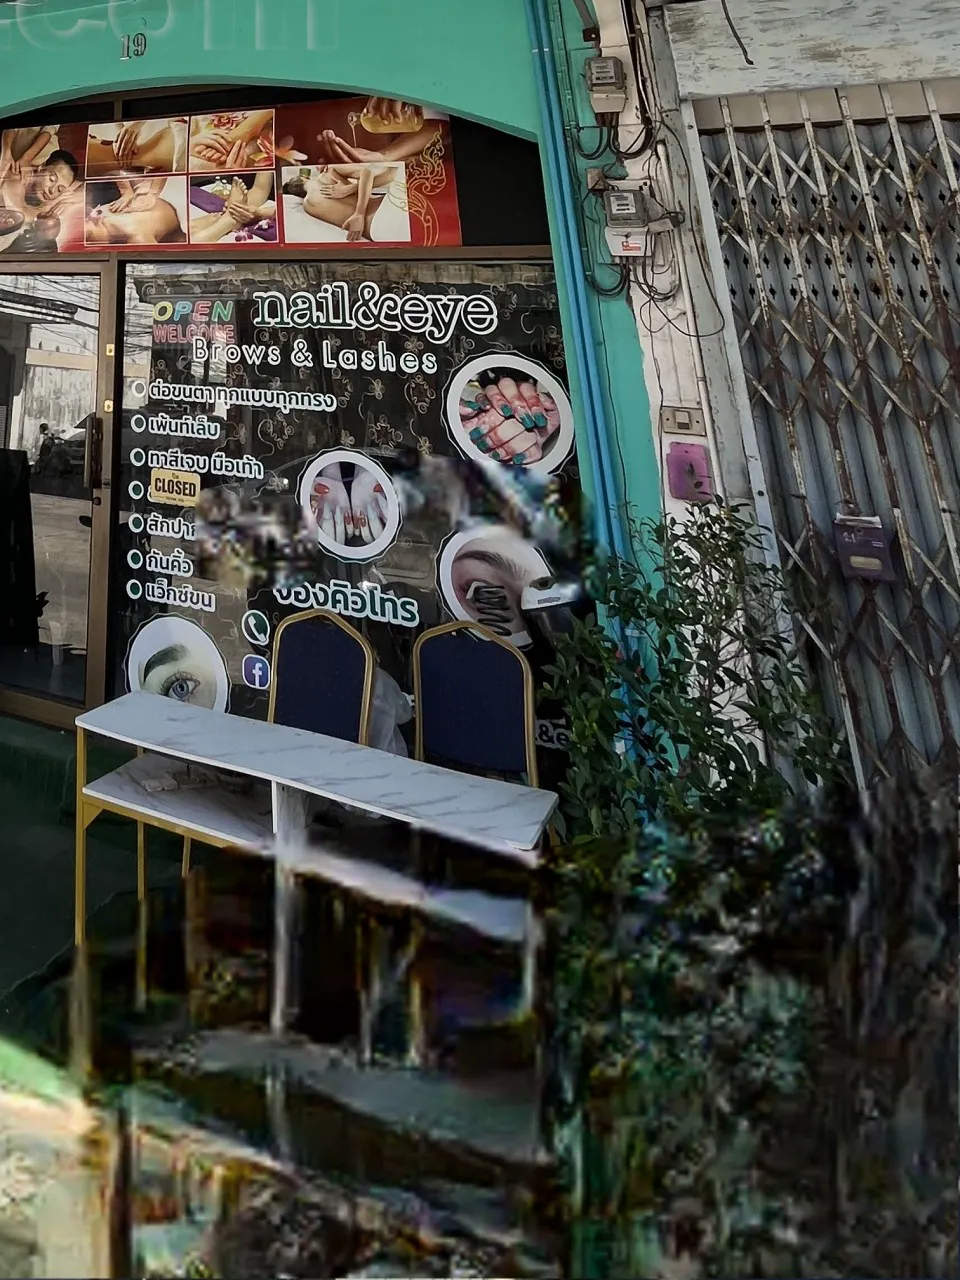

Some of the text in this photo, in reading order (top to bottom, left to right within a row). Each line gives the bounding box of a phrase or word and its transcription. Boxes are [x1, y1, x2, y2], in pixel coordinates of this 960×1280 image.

[119, 32, 147, 61] 19
[152, 300, 234, 322] OPEN
[253, 281, 499, 345] nail&eye
[192, 336, 438, 374] Brows & Lashes
[149, 378, 338, 414] ต่อขนตา ทุกแบบทุกทรง
[149, 413, 220, 440] เพ้นท์เล็บ
[211, 452, 264, 480] มือเท้า
[154, 477, 197, 498] CLOSED
[146, 548, 194, 578] กันคิ้ว
[145, 578, 216, 613] แว็กซ์ขน
